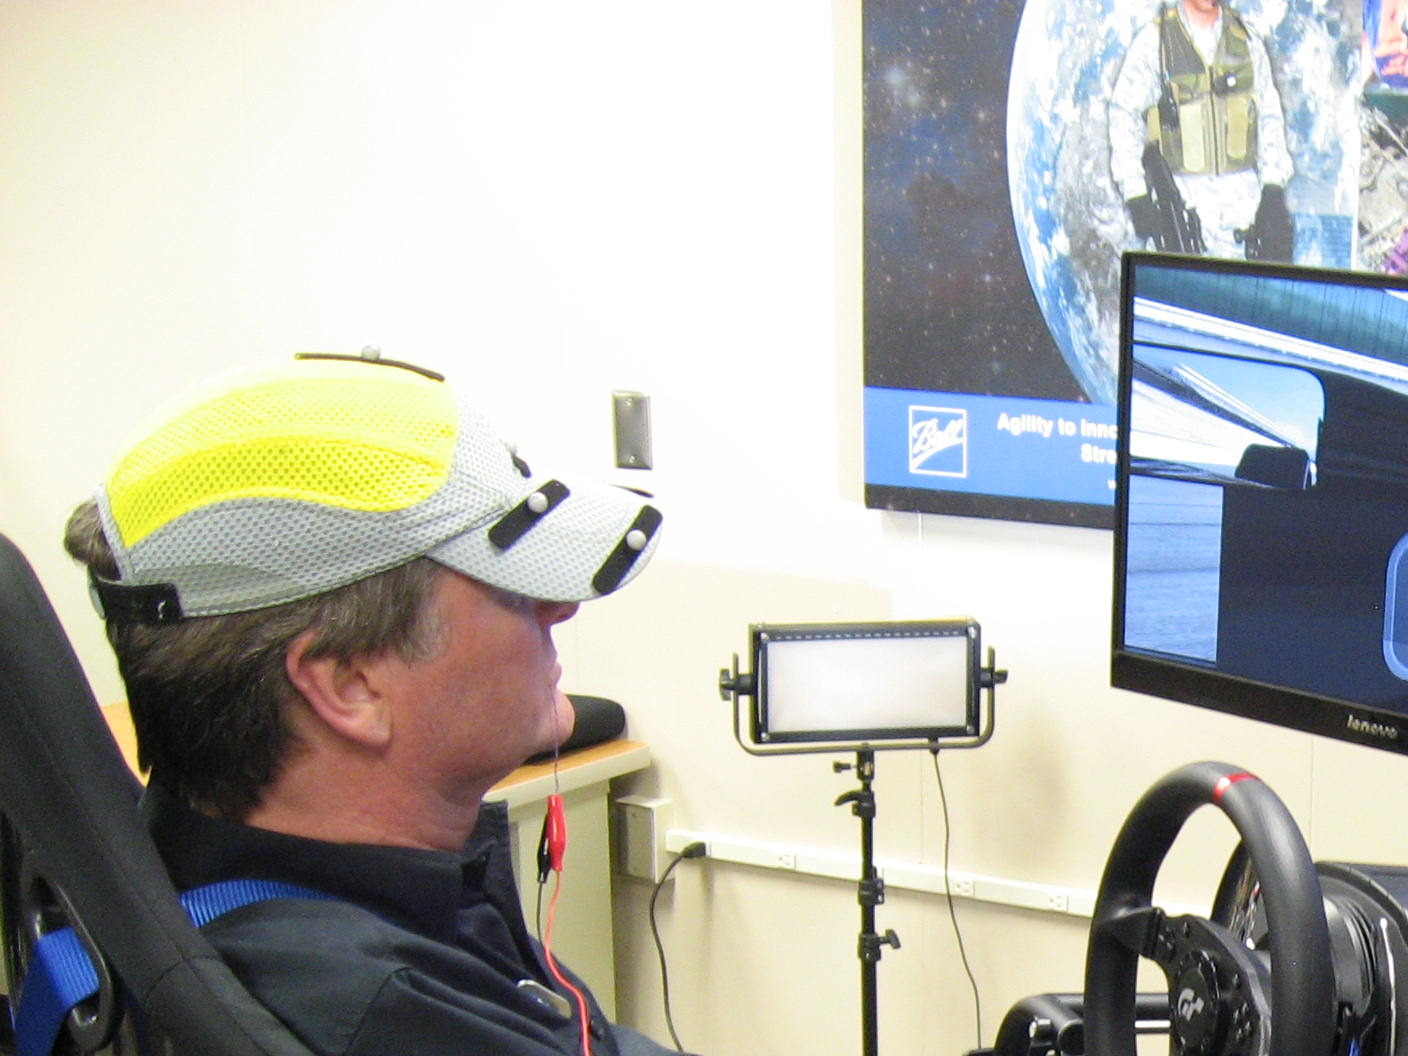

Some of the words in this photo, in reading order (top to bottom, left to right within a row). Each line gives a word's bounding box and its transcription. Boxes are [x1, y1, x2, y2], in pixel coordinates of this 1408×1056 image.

[911, 417, 964, 455] Ball
[997, 412, 1054, 438] Agility
[1058, 417, 1076, 436] to
